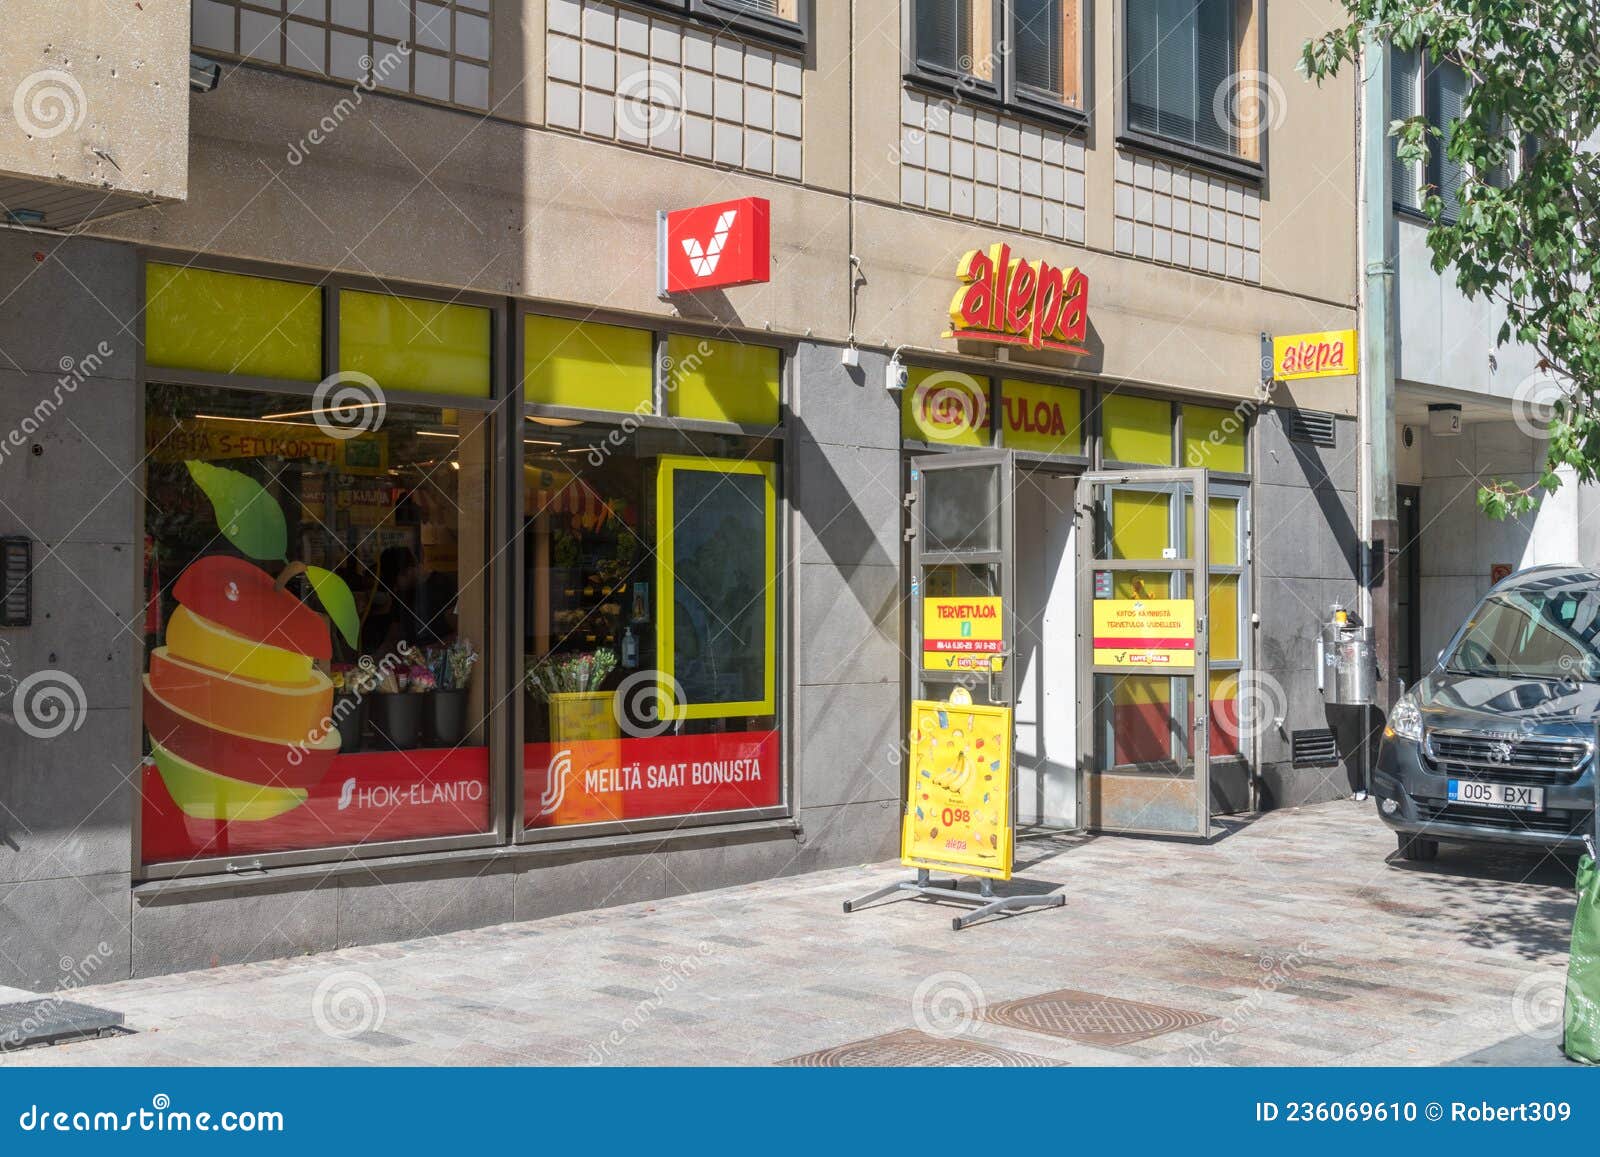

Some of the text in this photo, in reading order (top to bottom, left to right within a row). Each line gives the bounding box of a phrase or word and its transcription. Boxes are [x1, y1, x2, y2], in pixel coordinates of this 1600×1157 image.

[948, 241, 1089, 351] alepa
[1282, 340, 1345, 373] alepa
[937, 604, 997, 619] TERVETULOA
[585, 762, 642, 794] MEILTÄ
[647, 763, 687, 790] SAAT
[692, 758, 761, 786] BONUSTA
[358, 780, 483, 809] HOK-ELANTO
[1464, 784, 1537, 805] 005 BXL
[946, 839, 967, 850] alepa
